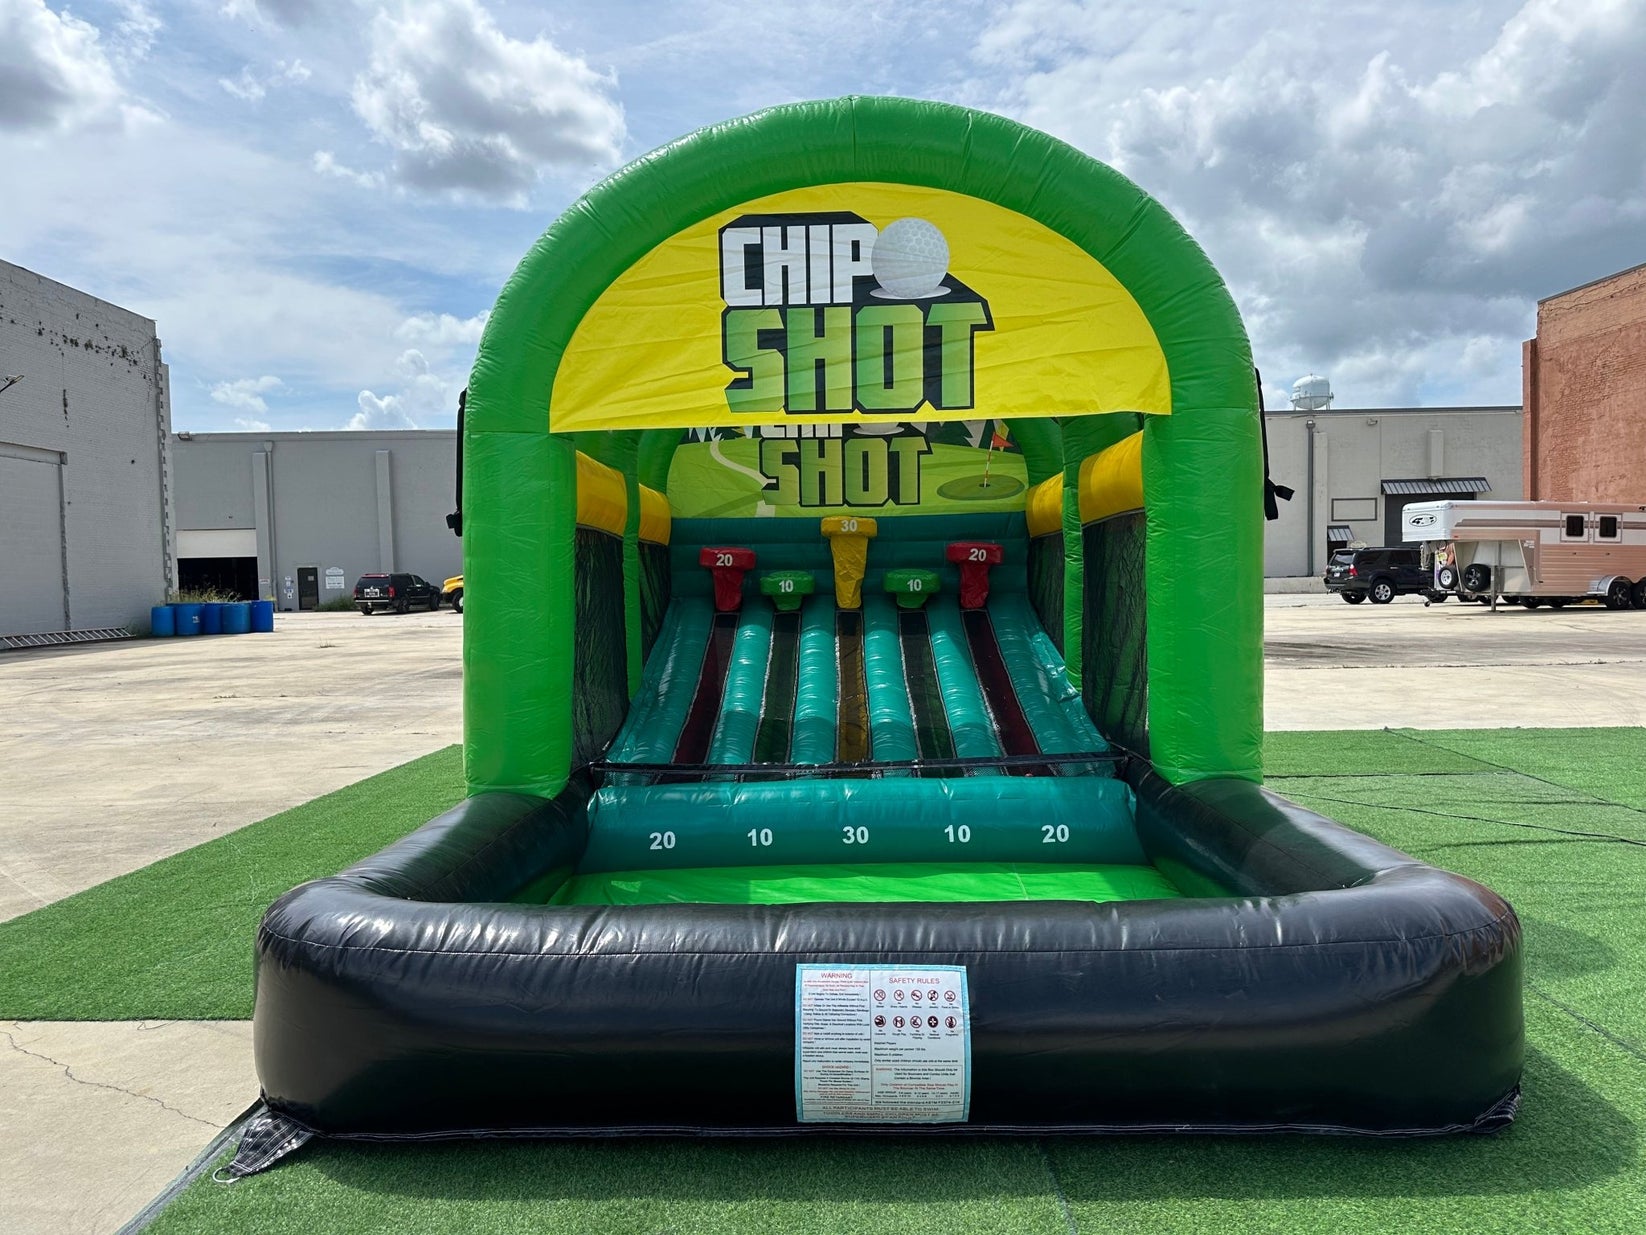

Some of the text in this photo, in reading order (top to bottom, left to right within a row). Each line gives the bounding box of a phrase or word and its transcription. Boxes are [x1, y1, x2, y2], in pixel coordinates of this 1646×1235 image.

[720, 222, 879, 307] CHIP
[723, 301, 990, 413] SHOT
[760, 435, 929, 507] SHOT
[840, 519, 858, 533] 30
[715, 553, 733, 567] 20
[968, 548, 987, 562] 20
[778, 579, 794, 593] 10
[906, 578, 922, 592] 10
[649, 823, 1070, 850] 20 10 30 10 20
